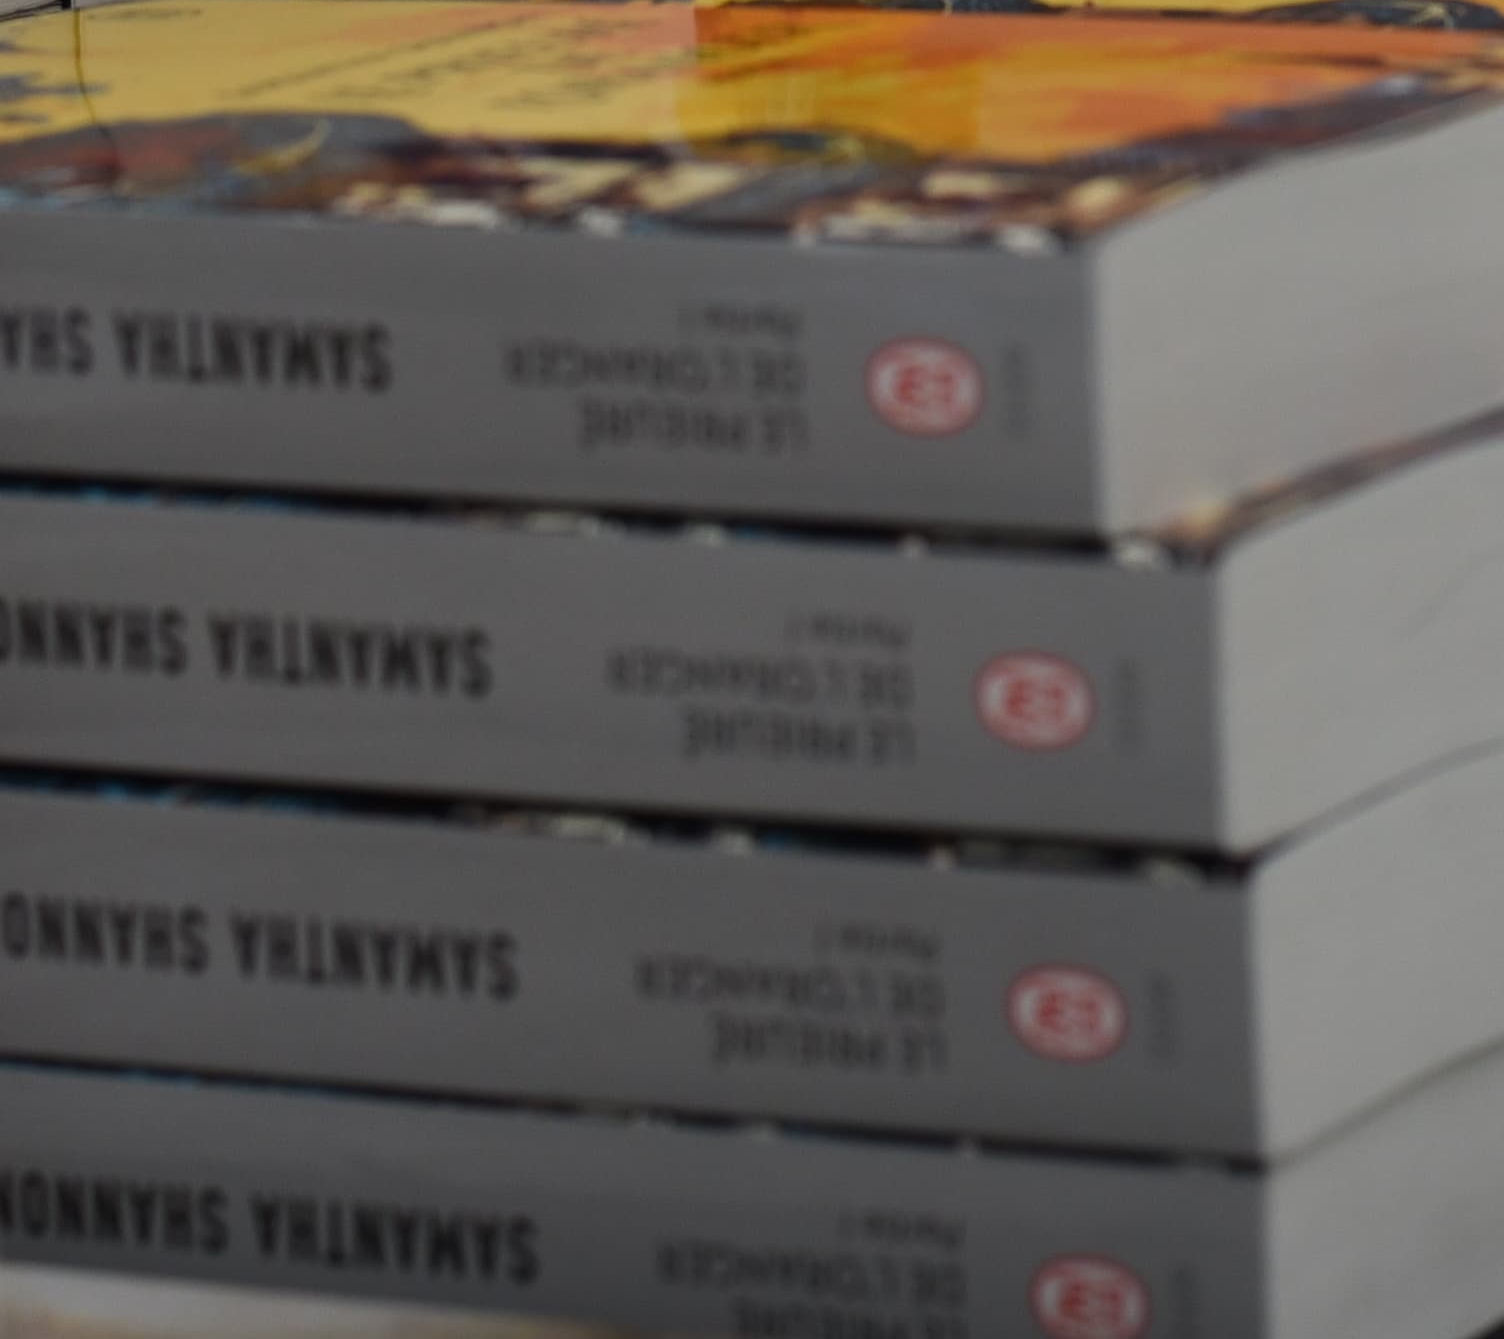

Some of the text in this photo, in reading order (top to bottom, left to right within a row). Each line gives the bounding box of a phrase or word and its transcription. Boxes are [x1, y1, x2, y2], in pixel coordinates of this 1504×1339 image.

[109, 307, 395, 393] SAMANTHA
[205, 611, 494, 699] SAMANTHA
[228, 913, 522, 1002] SAMANTHA
[248, 1193, 543, 1287] SAMANTHA
